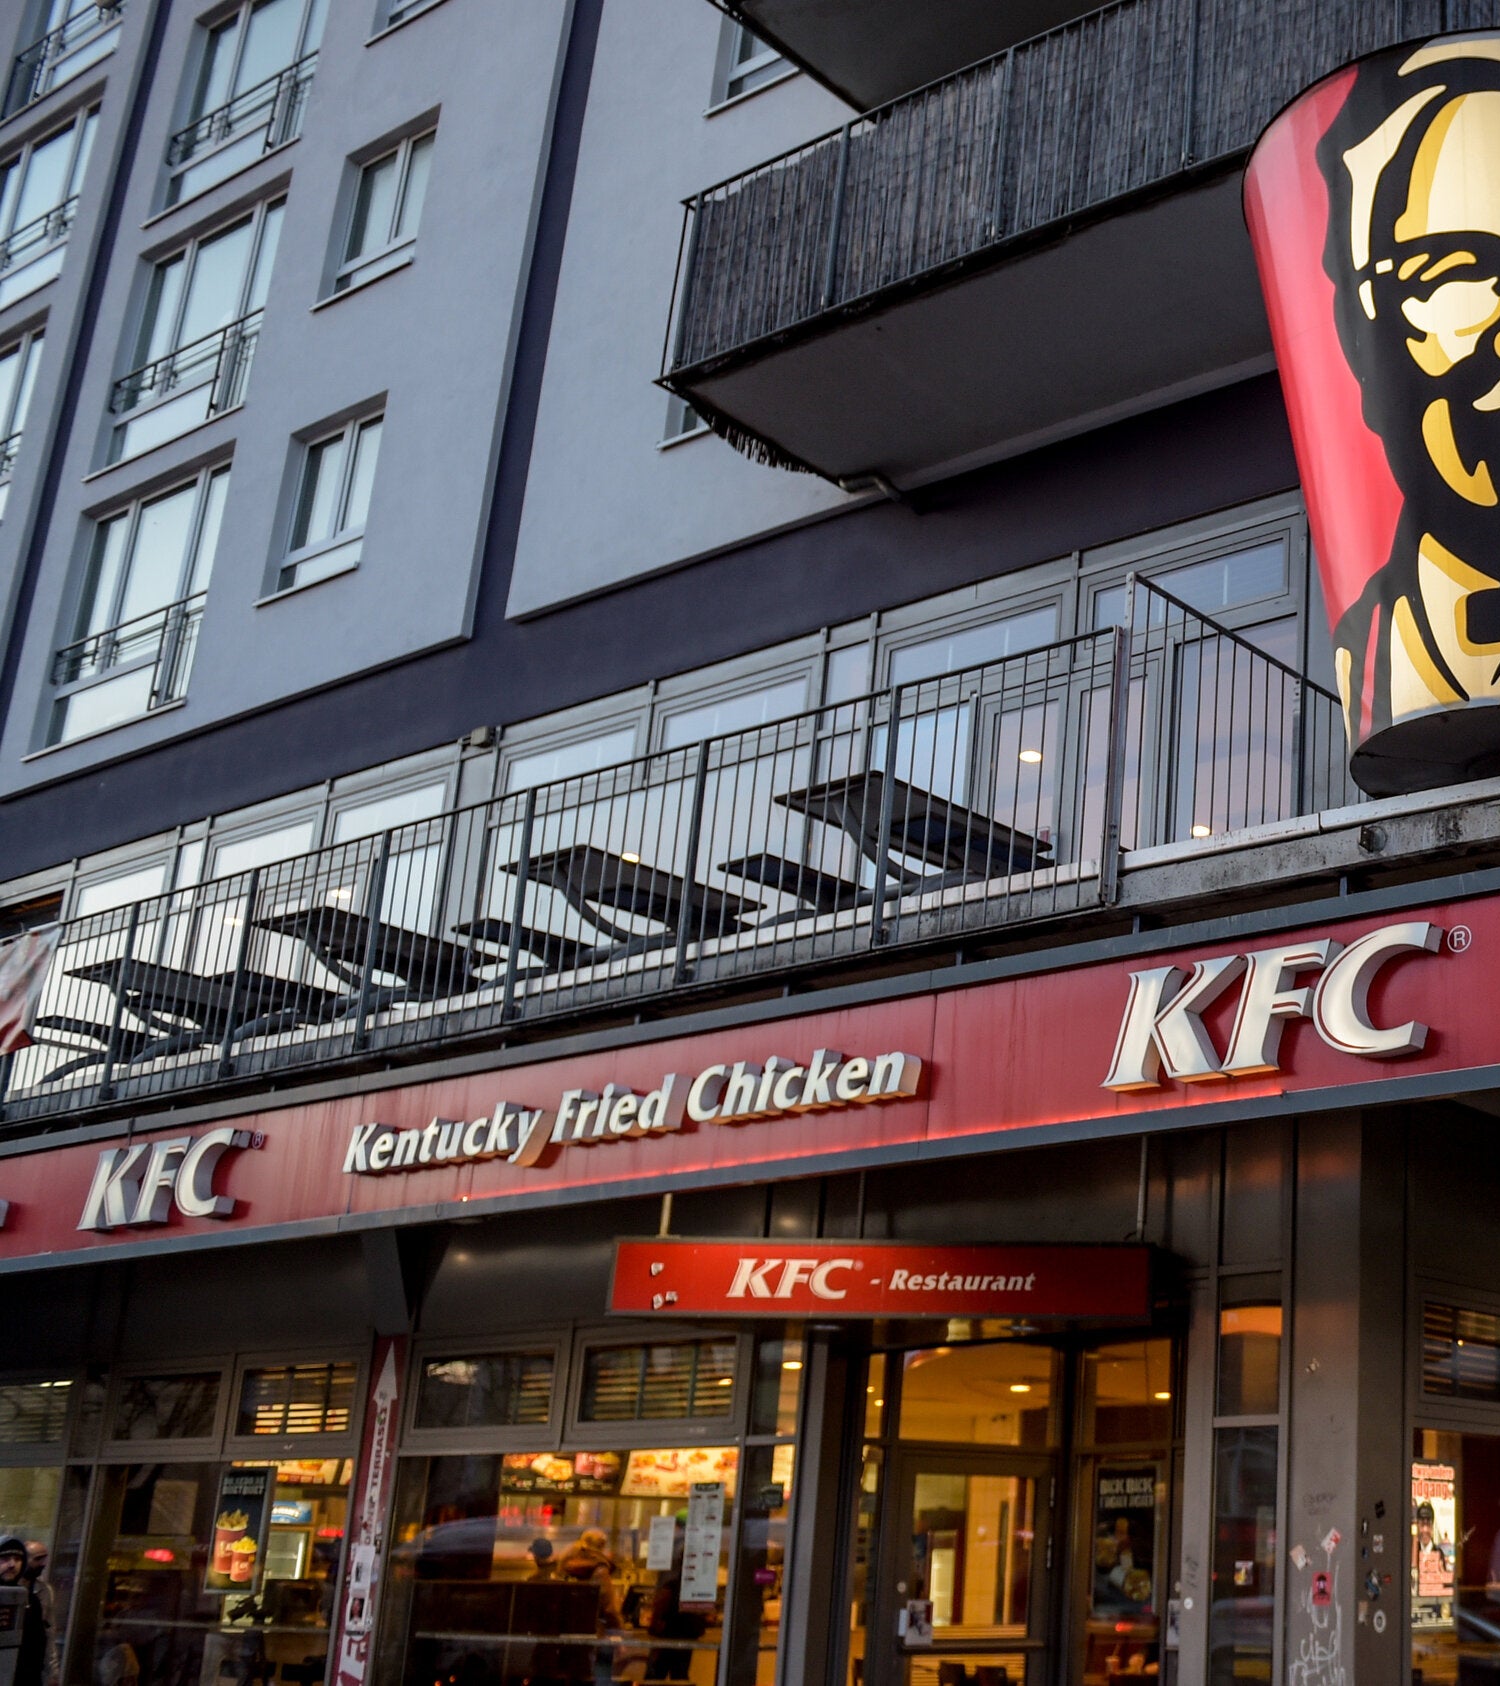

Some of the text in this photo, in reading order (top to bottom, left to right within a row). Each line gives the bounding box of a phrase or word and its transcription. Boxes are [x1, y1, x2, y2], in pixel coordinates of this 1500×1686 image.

[1100, 922, 1434, 1088] KFC
[343, 1048, 908, 1173] Kentucky Fried Chicken
[77, 1128, 238, 1230] KFC
[726, 1258, 854, 1300] KFC
[888, 1269, 1037, 1292] Restaurant
